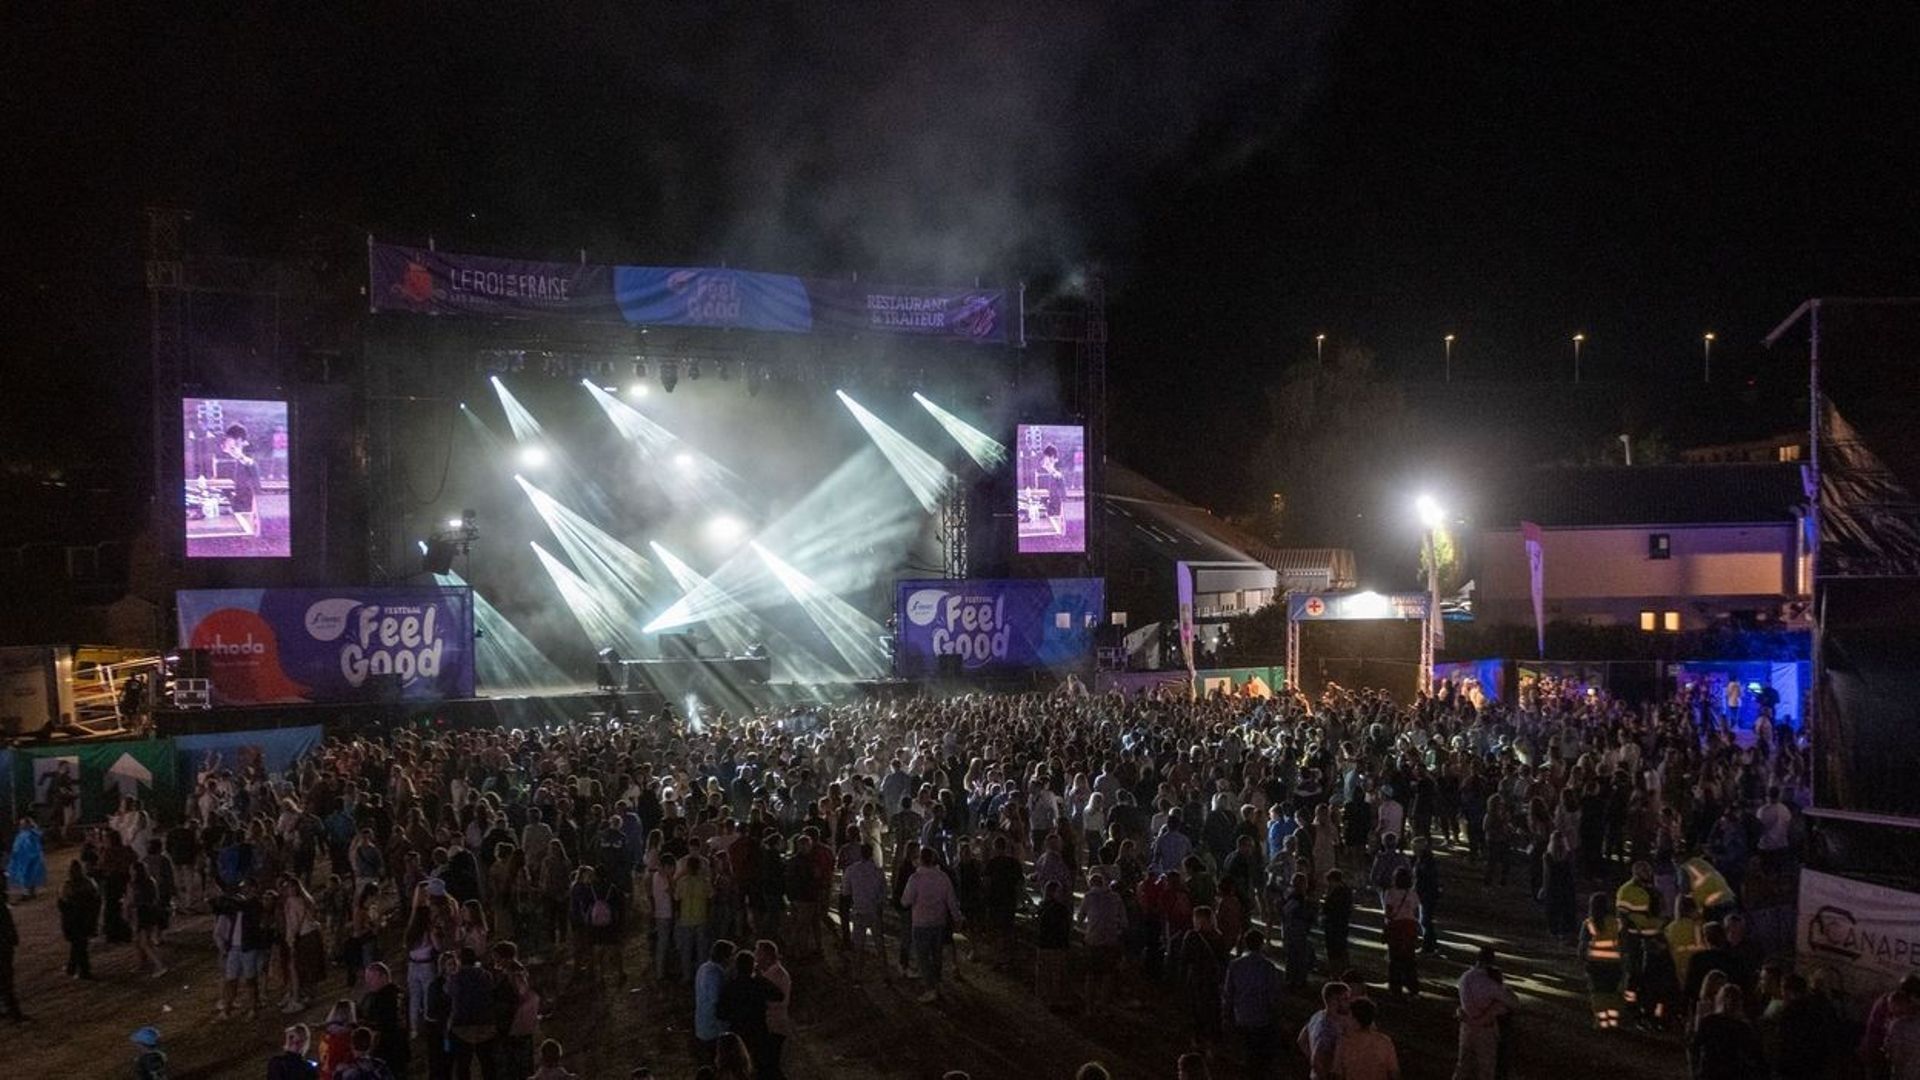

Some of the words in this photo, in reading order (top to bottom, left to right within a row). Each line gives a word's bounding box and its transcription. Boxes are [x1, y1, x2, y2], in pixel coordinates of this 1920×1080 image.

[519, 275, 569, 300] FRAISE
[866, 294, 950, 312] RESTAURANT
[883, 311, 945, 327] TRAITEUR
[359, 603, 436, 648] Feel
[946, 593, 1004, 633] Feel
[932, 623, 1011, 661] Good
[341, 637, 442, 687] Good
